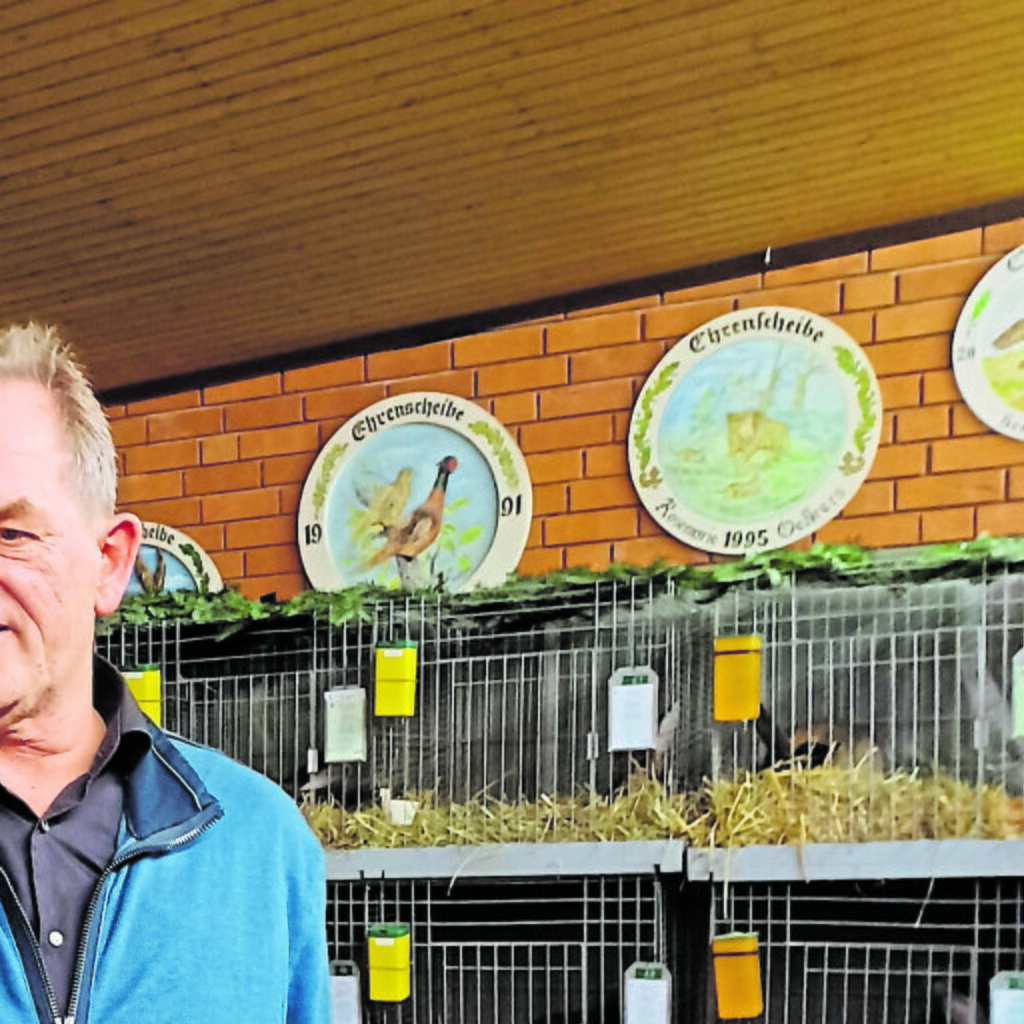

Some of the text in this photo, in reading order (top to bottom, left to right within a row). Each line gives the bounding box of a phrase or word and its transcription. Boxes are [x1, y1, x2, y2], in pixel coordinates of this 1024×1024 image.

[351, 397, 465, 441] Ehrenscheibe
[304, 494, 523, 546] 19 91
[724, 529, 769, 548] 1995
